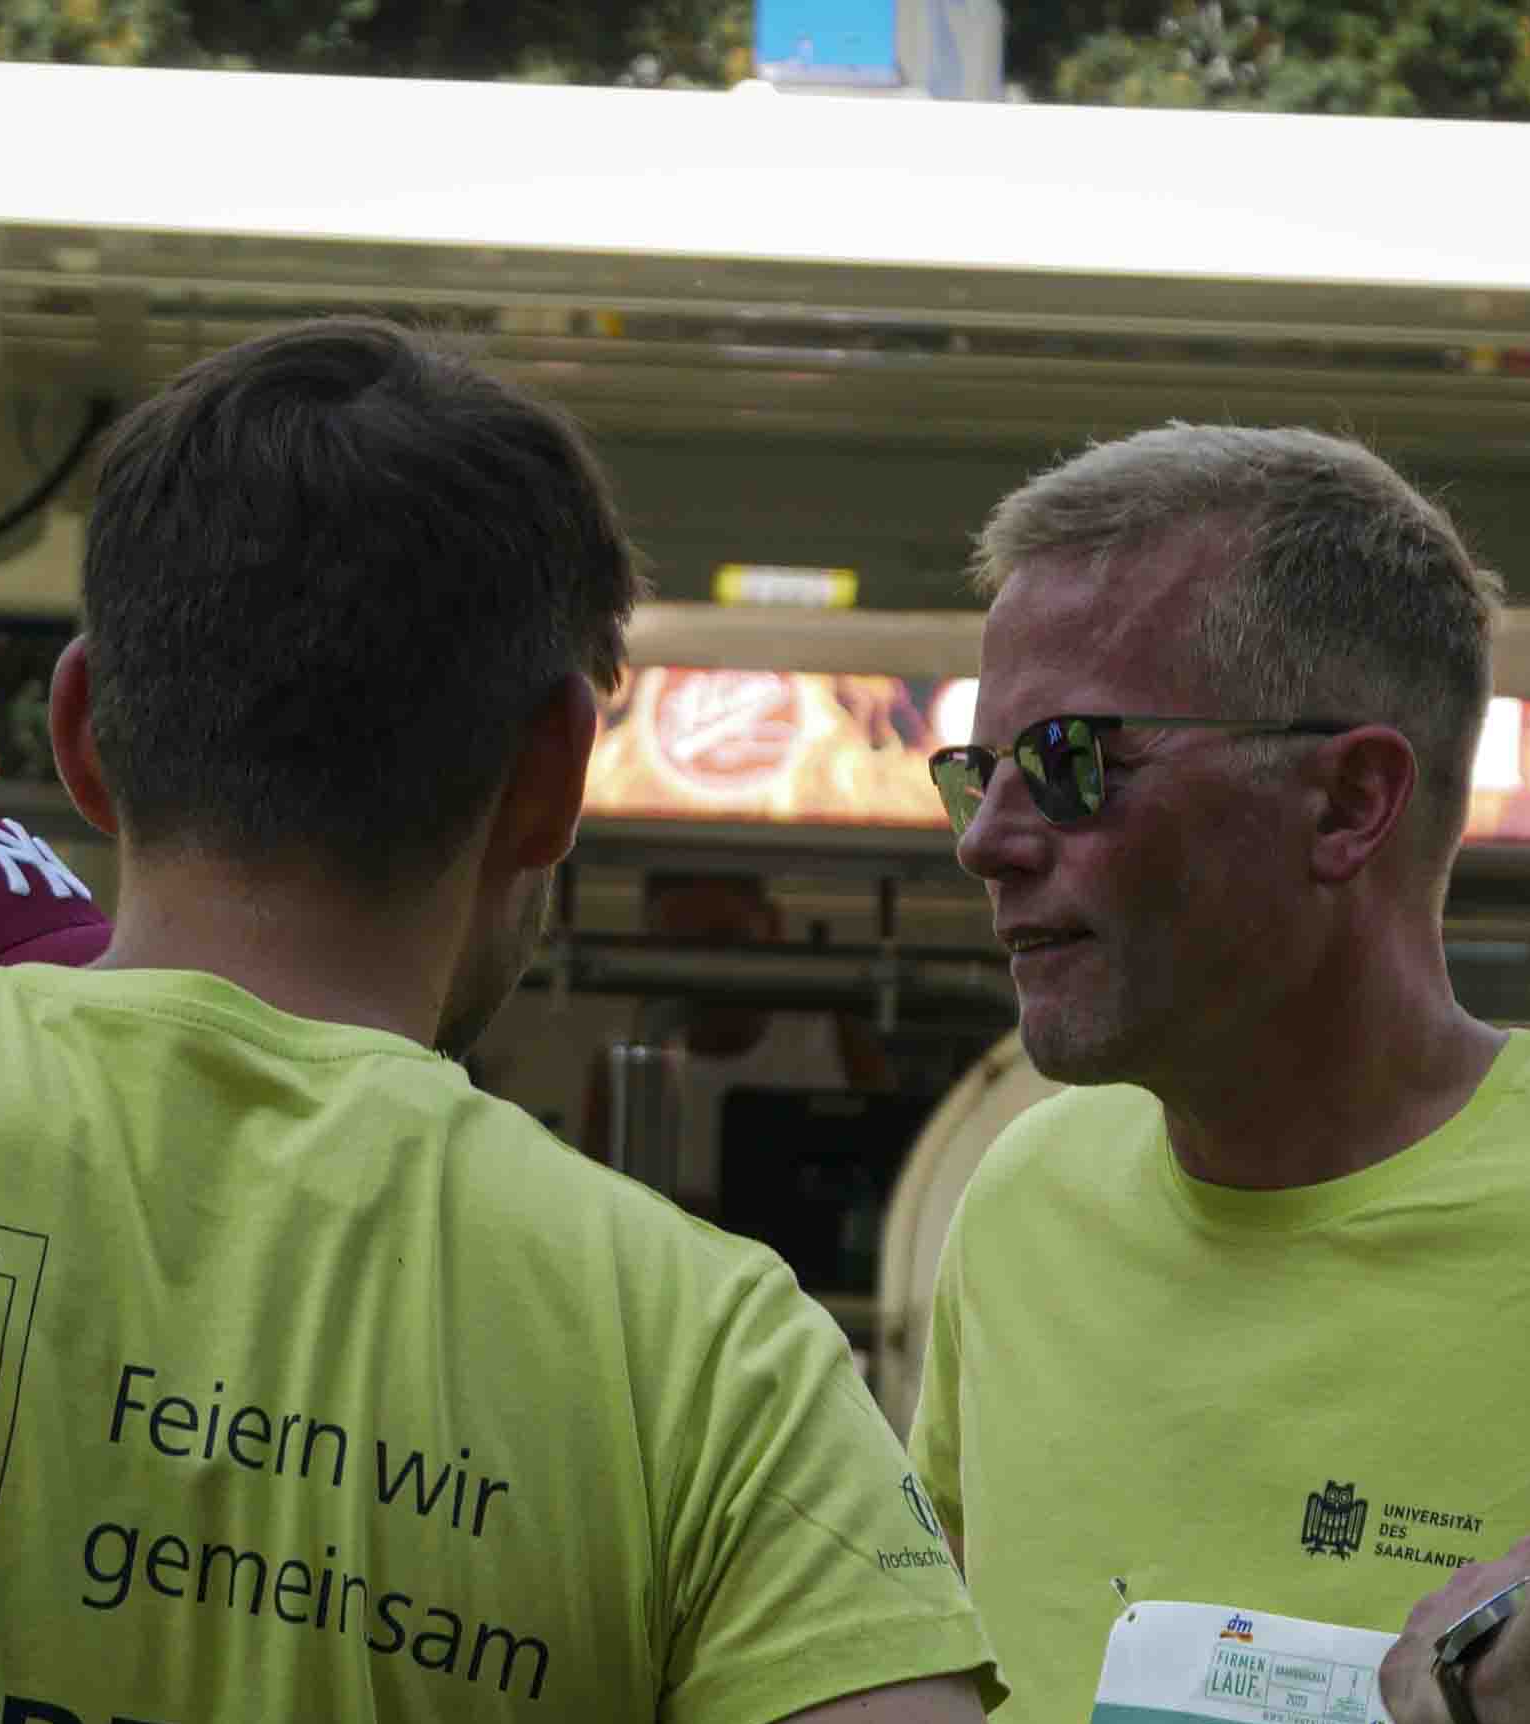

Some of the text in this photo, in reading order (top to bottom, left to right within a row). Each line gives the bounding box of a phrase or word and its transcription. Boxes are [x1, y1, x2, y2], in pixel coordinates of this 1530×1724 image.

[107, 1364, 350, 1488] Feiern
[375, 1440, 509, 1538] wir
[1379, 1523, 1407, 1540] DES
[1383, 1503, 1484, 1534] UNIVERSITÄT
[1374, 1543, 1475, 1569] SAARLANDE
[80, 1519, 551, 1700] gemeinsam
[1227, 1613, 1254, 1633] dm
[1218, 1651, 1267, 1674] FIRMEN
[1211, 1671, 1259, 1699] LAUF
